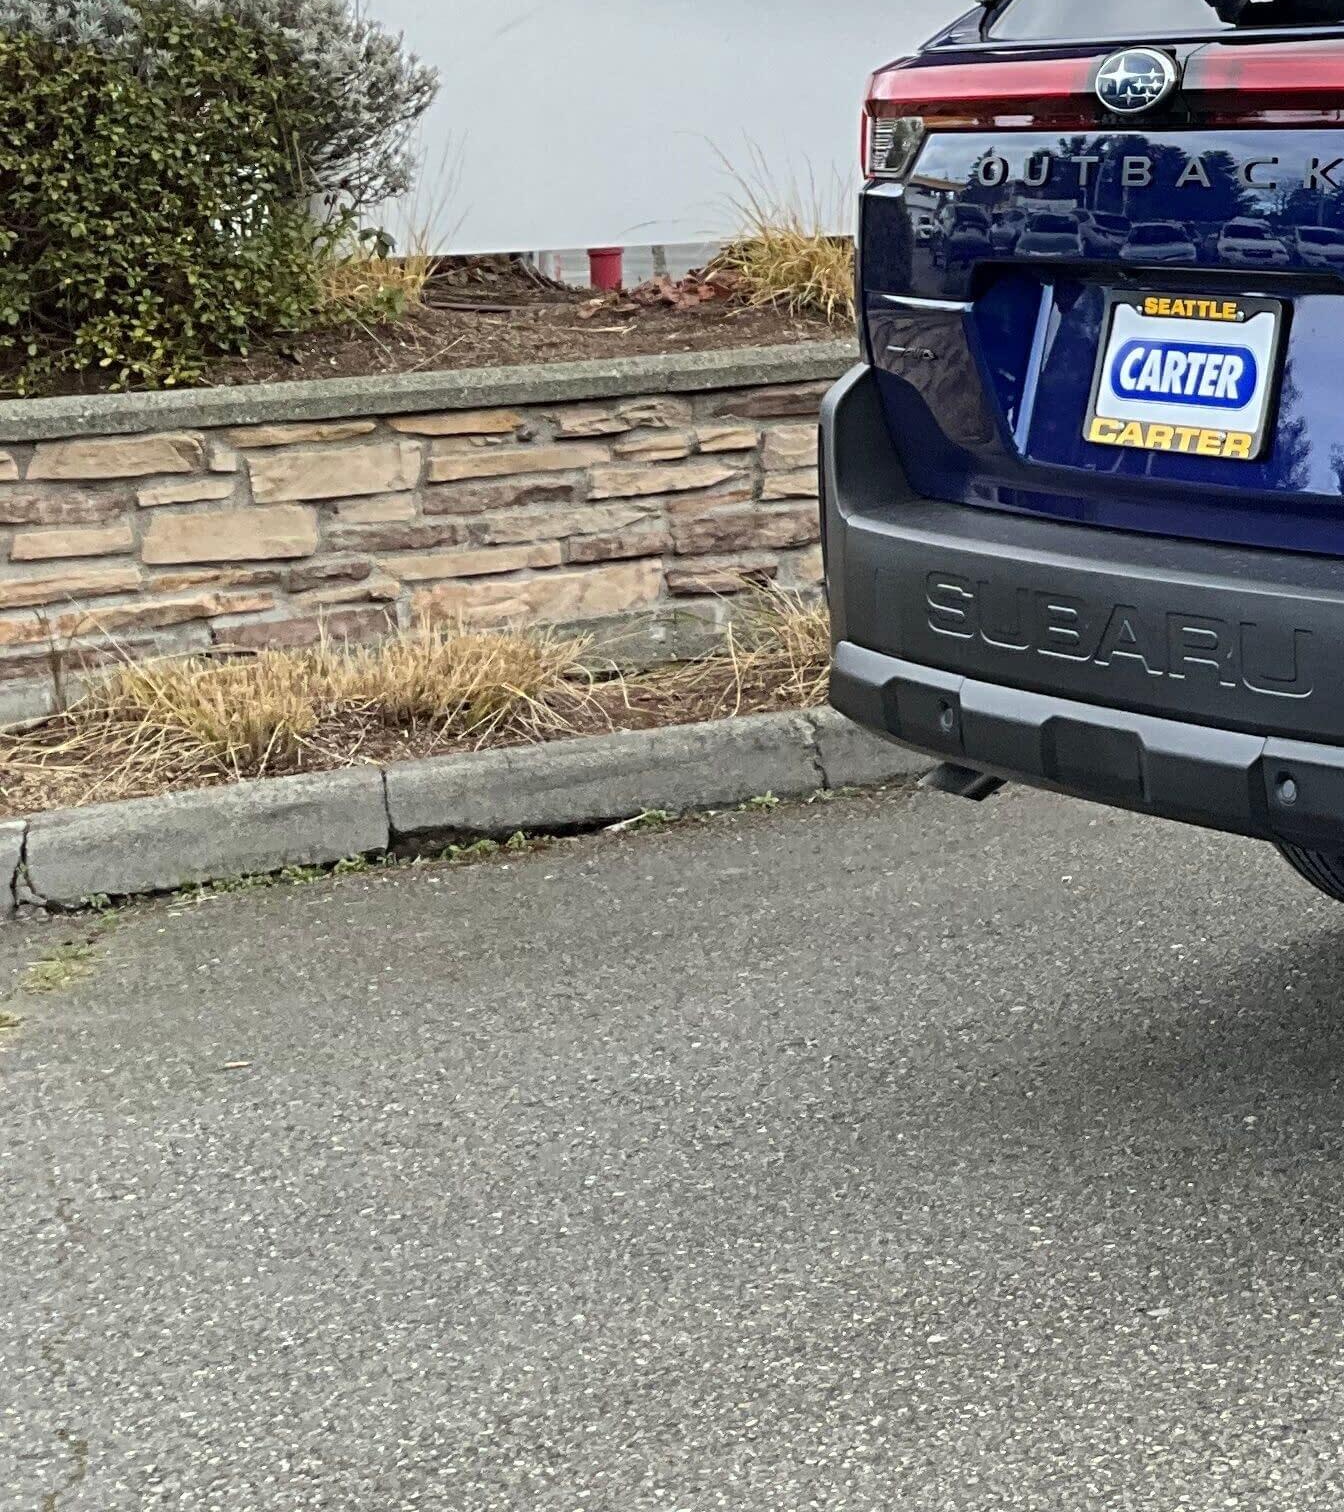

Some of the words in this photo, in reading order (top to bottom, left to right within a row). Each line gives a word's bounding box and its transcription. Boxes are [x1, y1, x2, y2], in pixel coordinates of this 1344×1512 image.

[977, 155, 1344, 190] OUTBACK
[1144, 297, 1237, 320] SEATTLE
[1119, 346, 1244, 400] CARTER
[1088, 418, 1252, 460] CARTER
[925, 570, 1313, 699] SUBARU
